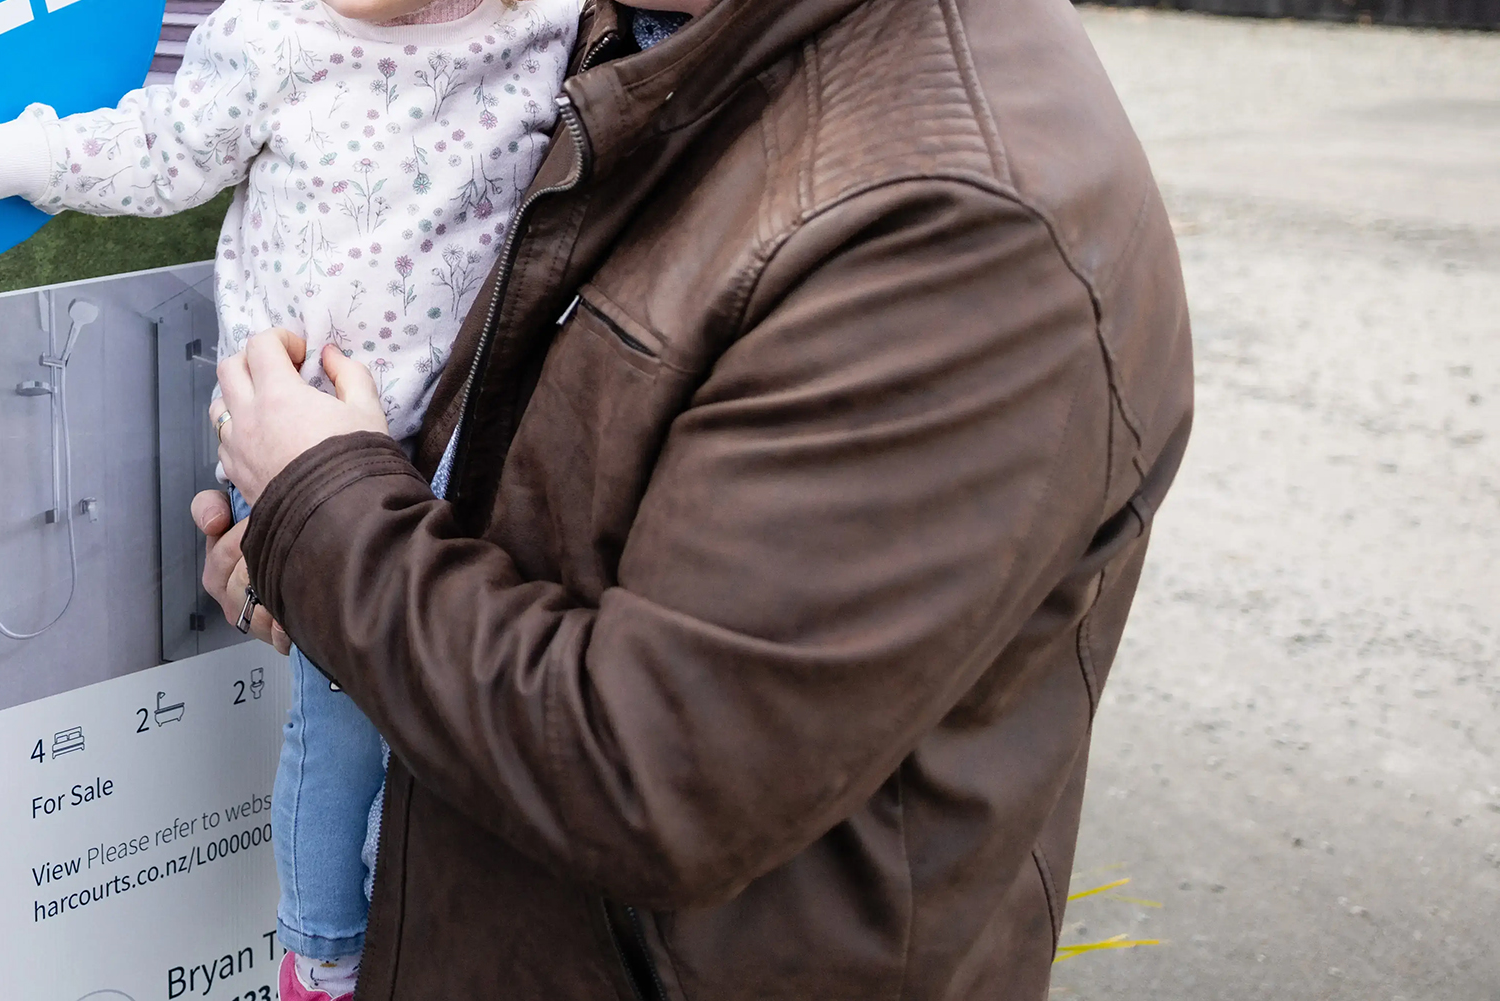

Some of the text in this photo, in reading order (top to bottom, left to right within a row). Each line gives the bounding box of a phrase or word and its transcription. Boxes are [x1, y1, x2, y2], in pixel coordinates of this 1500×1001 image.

[30, 680, 247, 764] 4 2 2
[31, 777, 114, 819] For Sale
[31, 857, 82, 887] View
[87, 834, 150, 869] Please
[154, 817, 198, 847] refer
[201, 811, 221, 831] to
[33, 822, 273, 922] harcourts.co.nz/L000000
[168, 946, 254, 1000] Bryan
